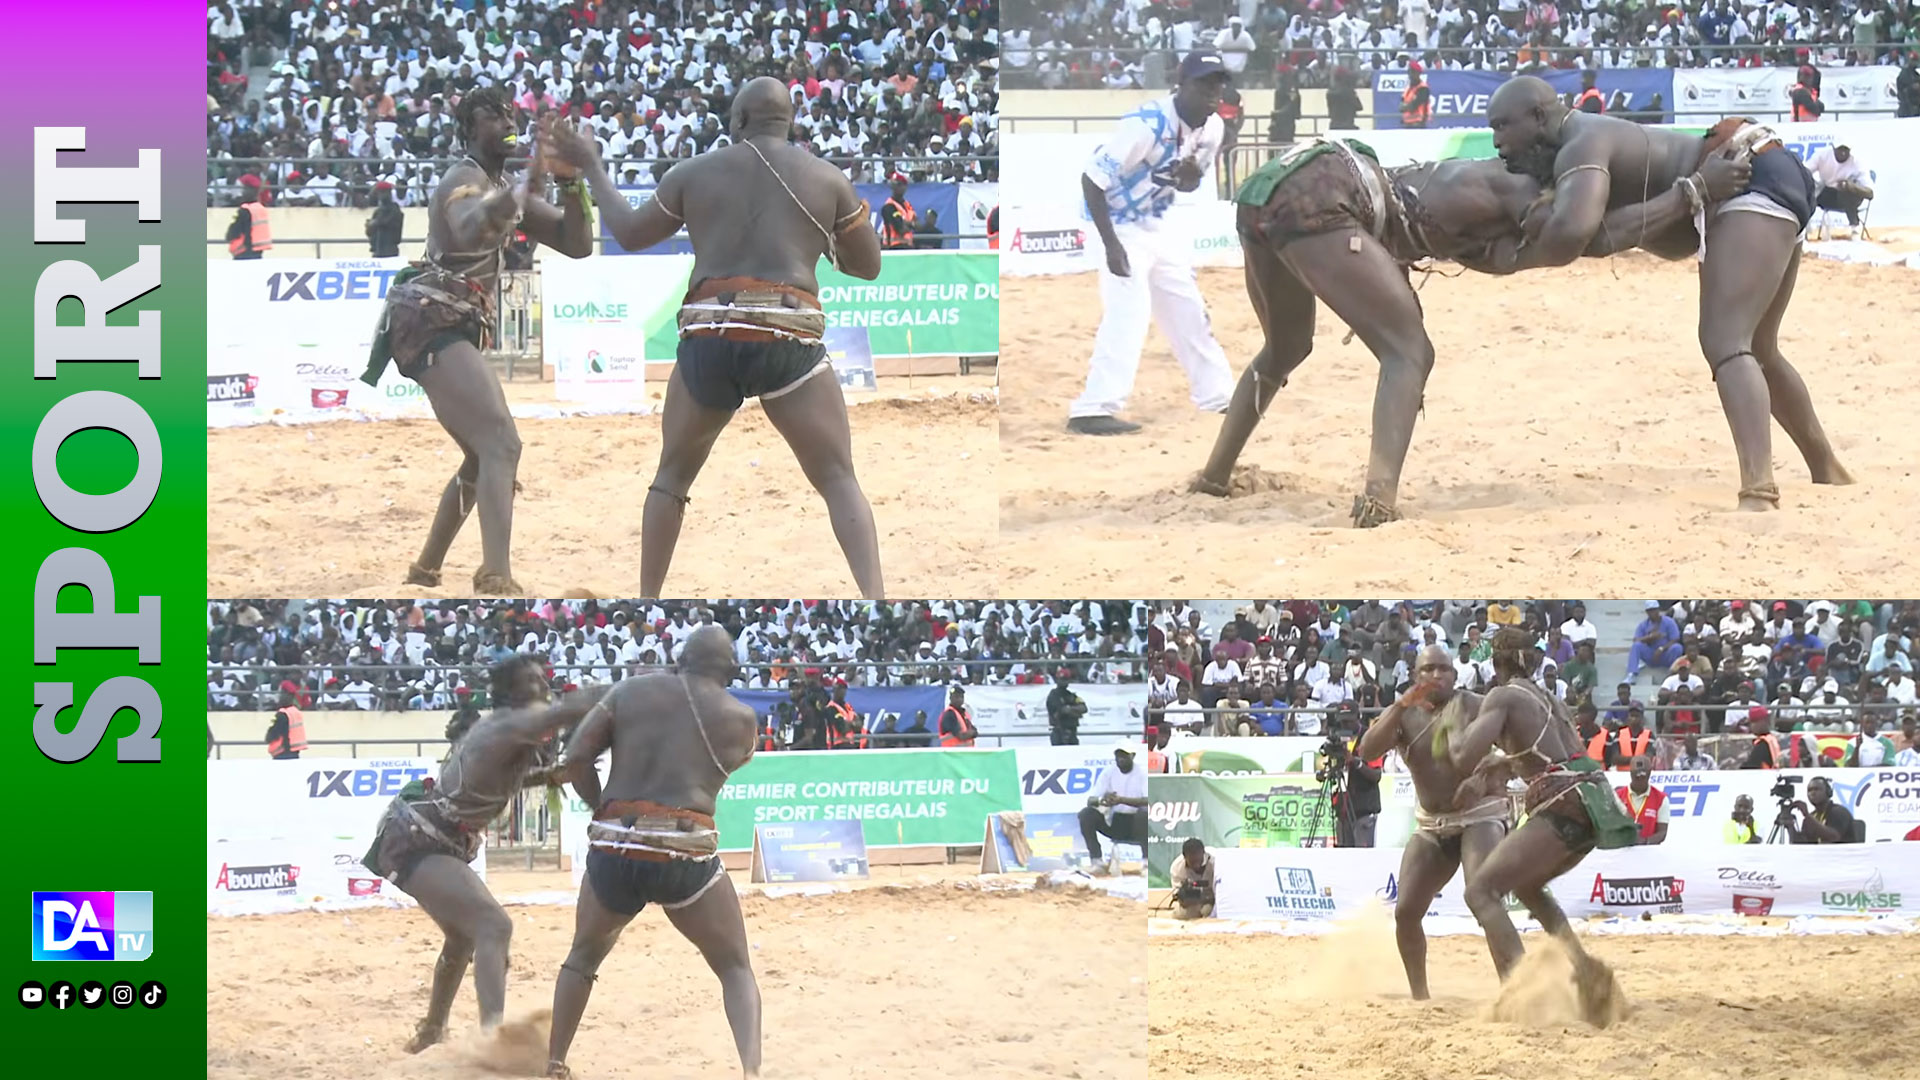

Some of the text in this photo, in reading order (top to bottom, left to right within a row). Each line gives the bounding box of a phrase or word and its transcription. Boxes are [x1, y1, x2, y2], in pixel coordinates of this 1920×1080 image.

[335, 261, 383, 269] SENEGAL
[267, 269, 401, 301] 1XBET
[817, 284, 968, 304] ONTRIBUTEUR
[826, 308, 960, 328] SENEGALAIS
[369, 760, 413, 768] SENEGAL
[1022, 767, 1104, 796] 1XB
[1650, 775, 1702, 784] SENEGAL
[718, 778, 990, 800] REMIER CONTRIBUTEUR DU
[1271, 800, 1299, 817] GO
[1663, 785, 1720, 817] ET
[754, 802, 947, 822] SPORT SENEGALAIS
[1244, 806, 1268, 821] GO
[1291, 897, 1336, 910] FLECHA
[1660, 905, 1684, 914] events
